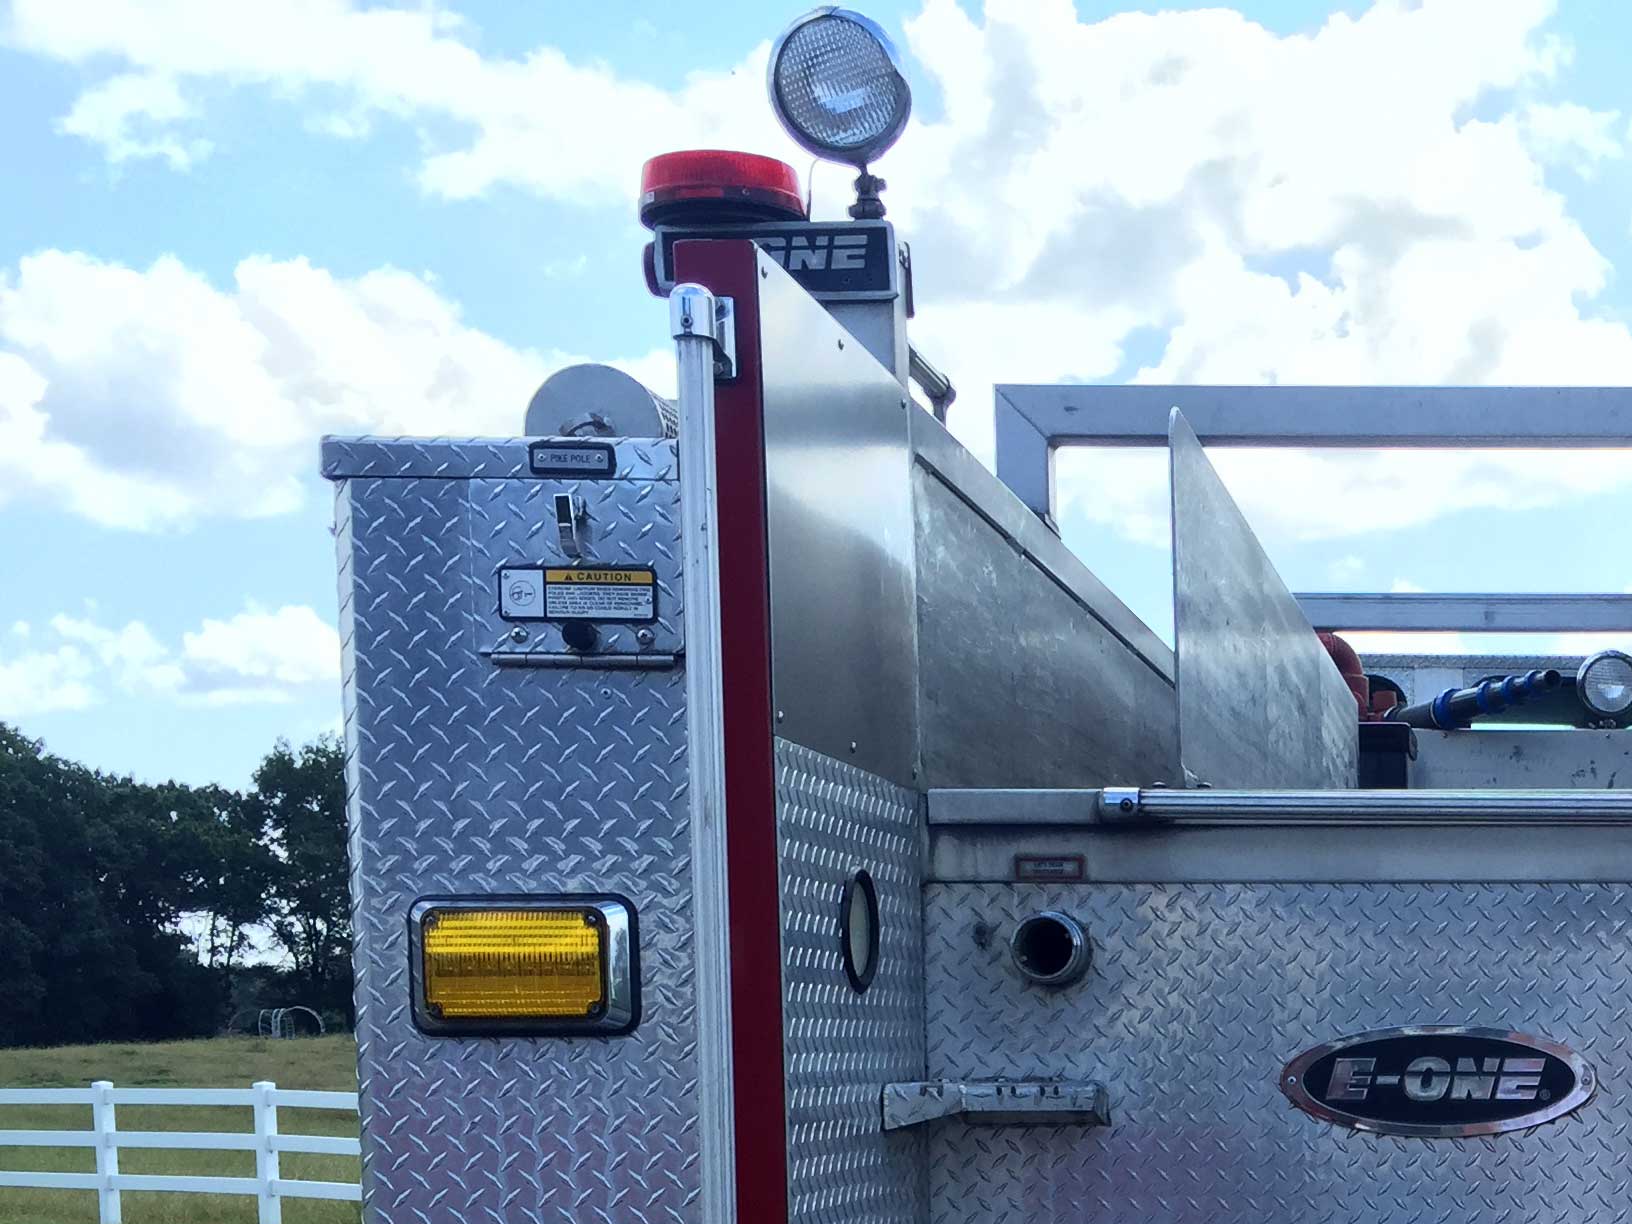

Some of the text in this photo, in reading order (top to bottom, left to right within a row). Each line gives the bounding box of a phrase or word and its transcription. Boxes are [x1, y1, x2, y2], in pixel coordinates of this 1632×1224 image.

[570, 454, 591, 464] POLE
[577, 572, 632, 581] CAUTION
[1325, 1055, 1547, 1101] E-ONE
